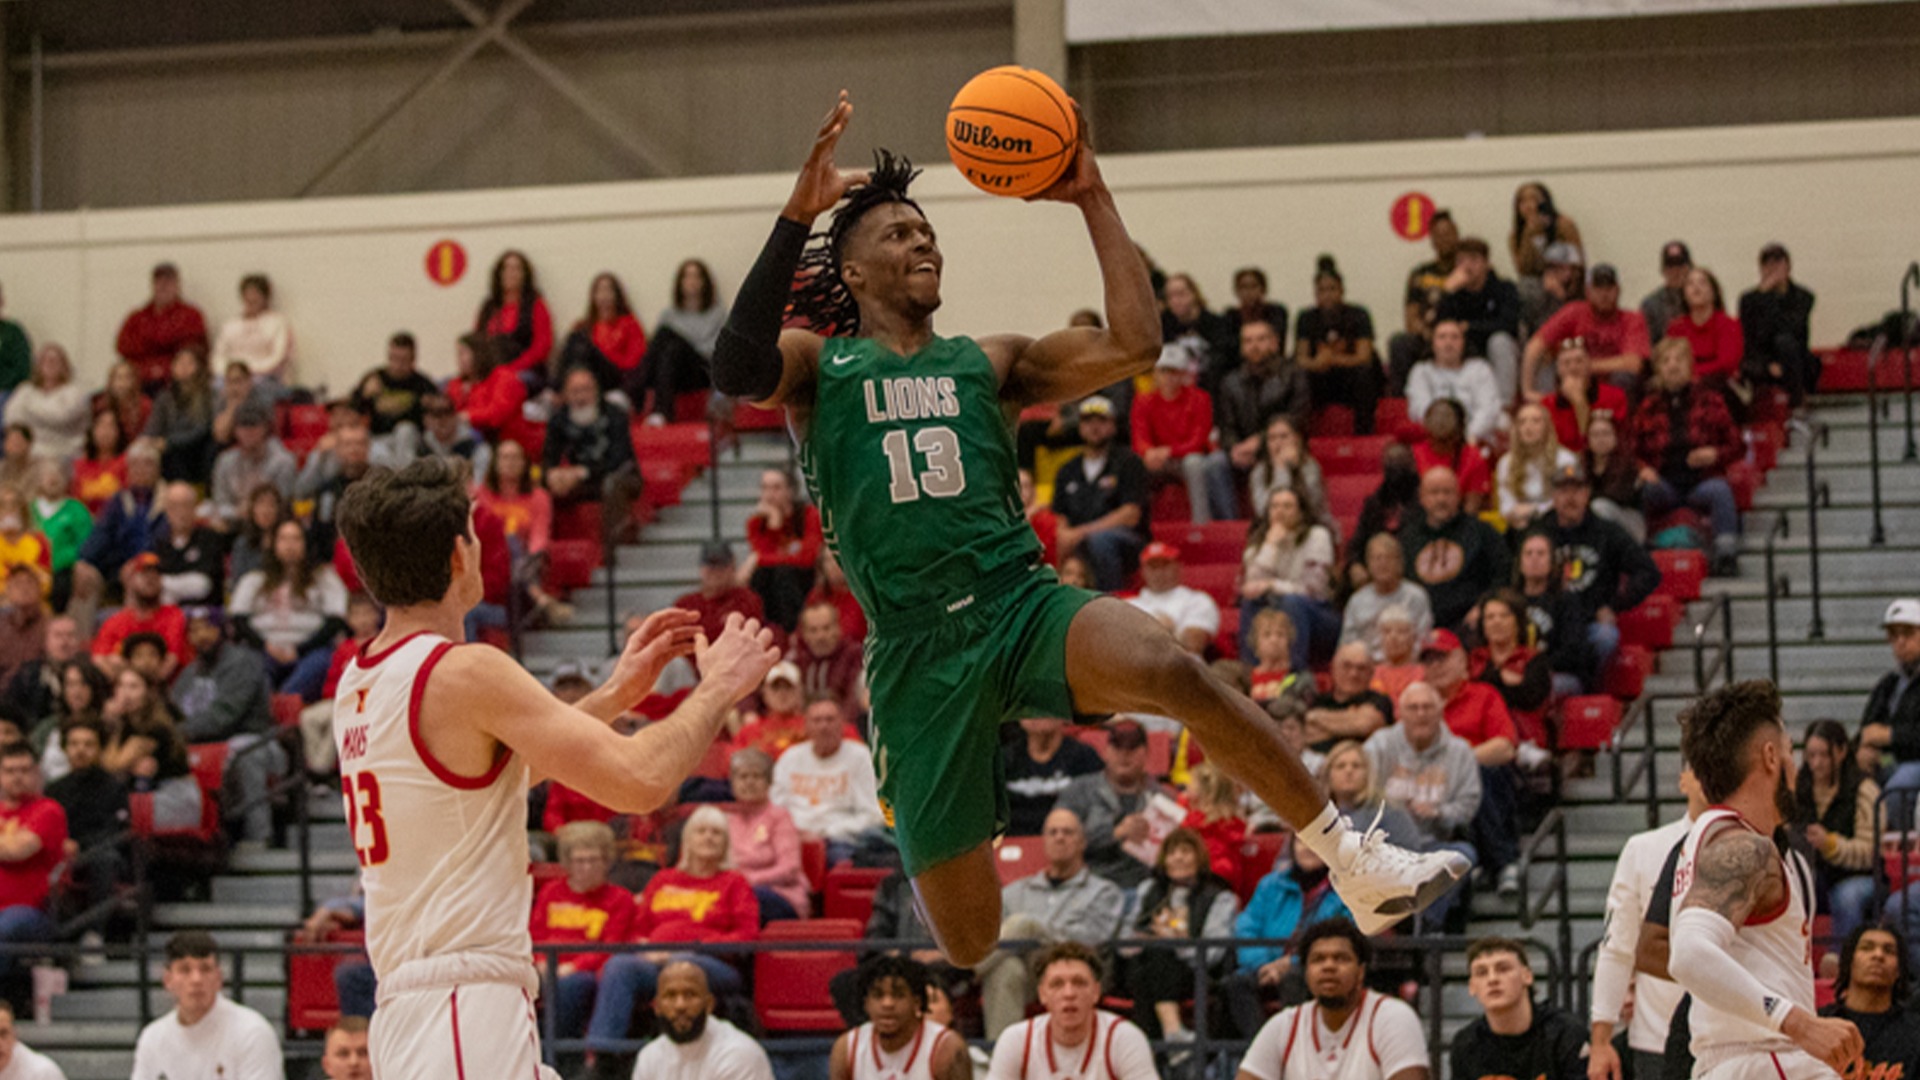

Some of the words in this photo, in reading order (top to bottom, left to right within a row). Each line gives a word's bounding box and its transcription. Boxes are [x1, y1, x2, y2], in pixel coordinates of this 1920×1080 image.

[954, 118, 1032, 153] Wilson
[863, 376, 960, 423] LIONS
[882, 426, 966, 503] 13
